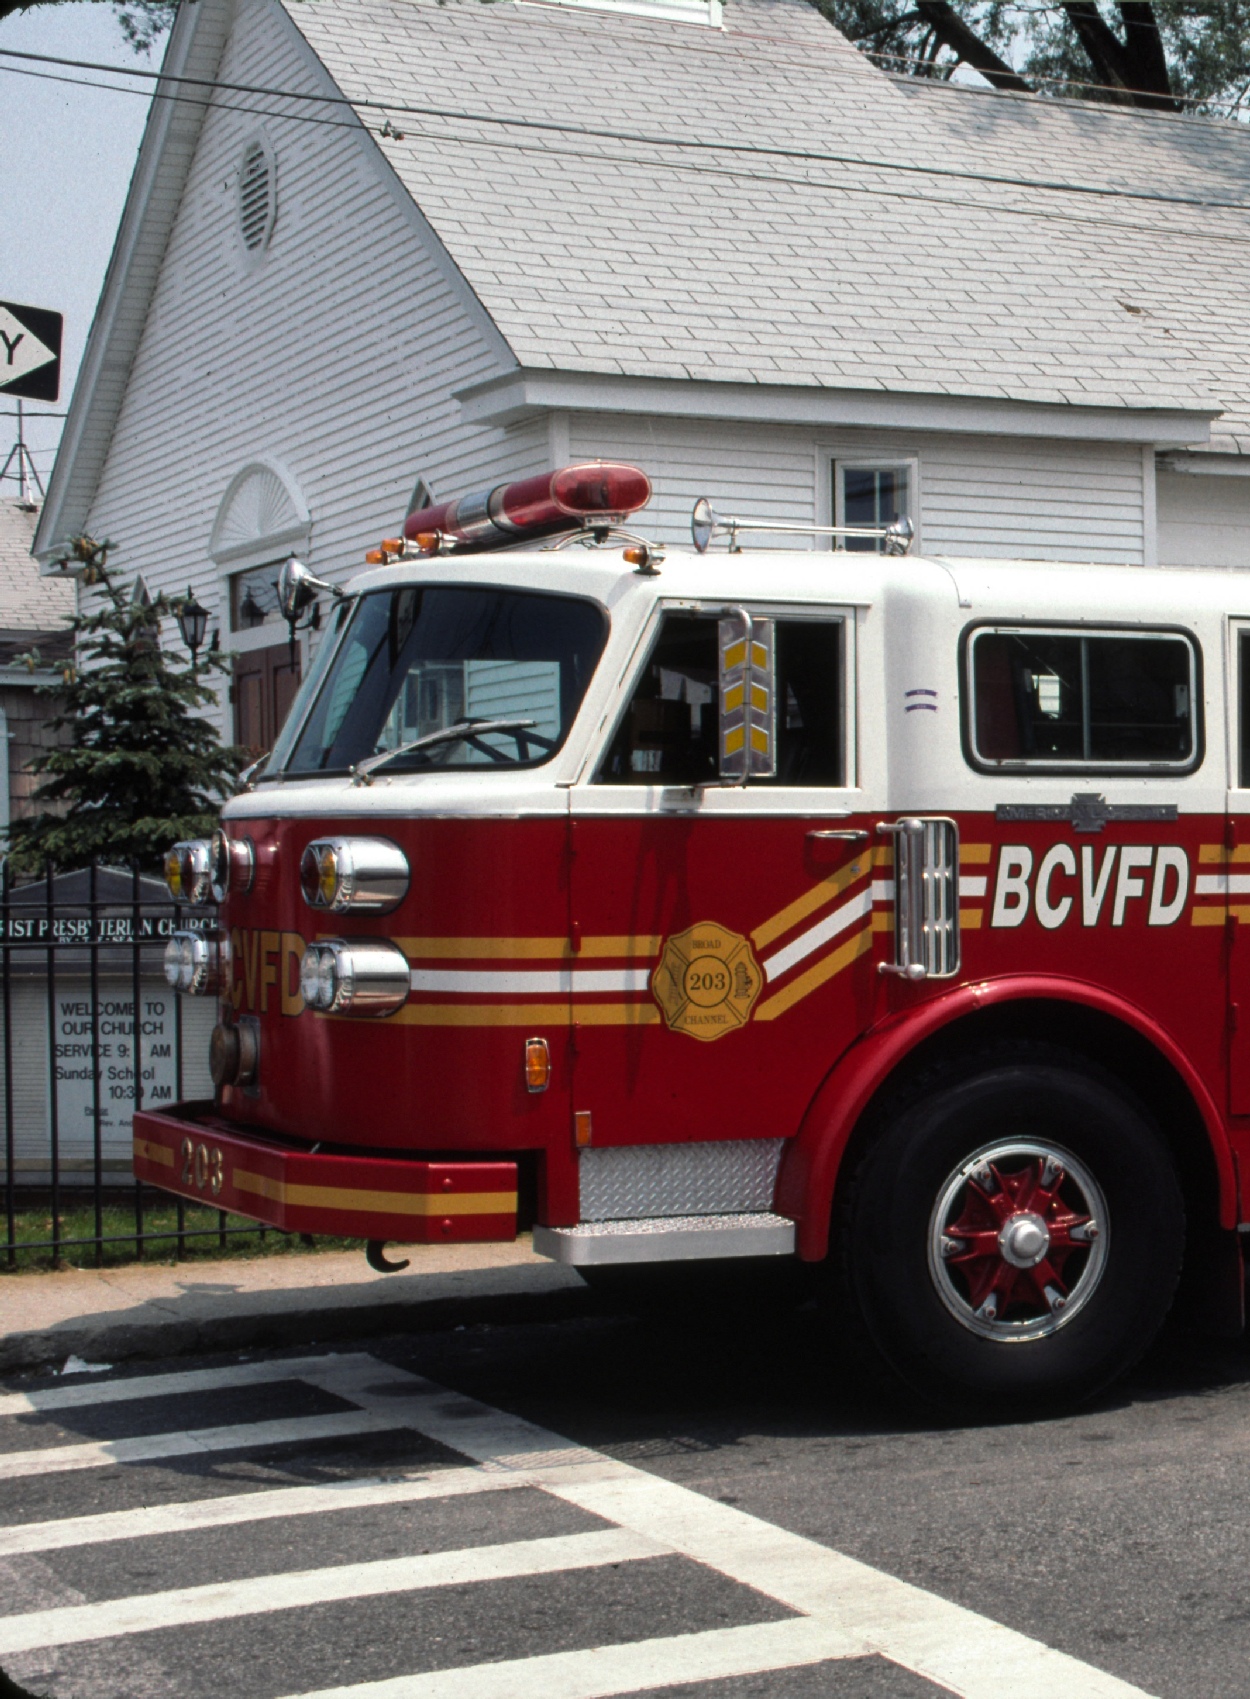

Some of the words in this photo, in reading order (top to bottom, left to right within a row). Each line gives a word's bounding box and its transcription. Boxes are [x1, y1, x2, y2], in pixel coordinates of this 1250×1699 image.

[991, 842, 1190, 929] BCVFD
[690, 972, 726, 991] 203
[61, 1002, 137, 1016] WELCOME
[144, 1002, 165, 1016] TO
[684, 1014, 729, 1025] CHANNEL
[62, 1021, 95, 1035] OUR
[101, 1021, 164, 1035] CHUCH
[54, 1044, 112, 1058] SERVCE
[150, 1044, 171, 1058] AM
[108, 1066, 155, 1080] Schol
[150, 1085, 171, 1099] AM
[180, 1136, 224, 1195] 203
